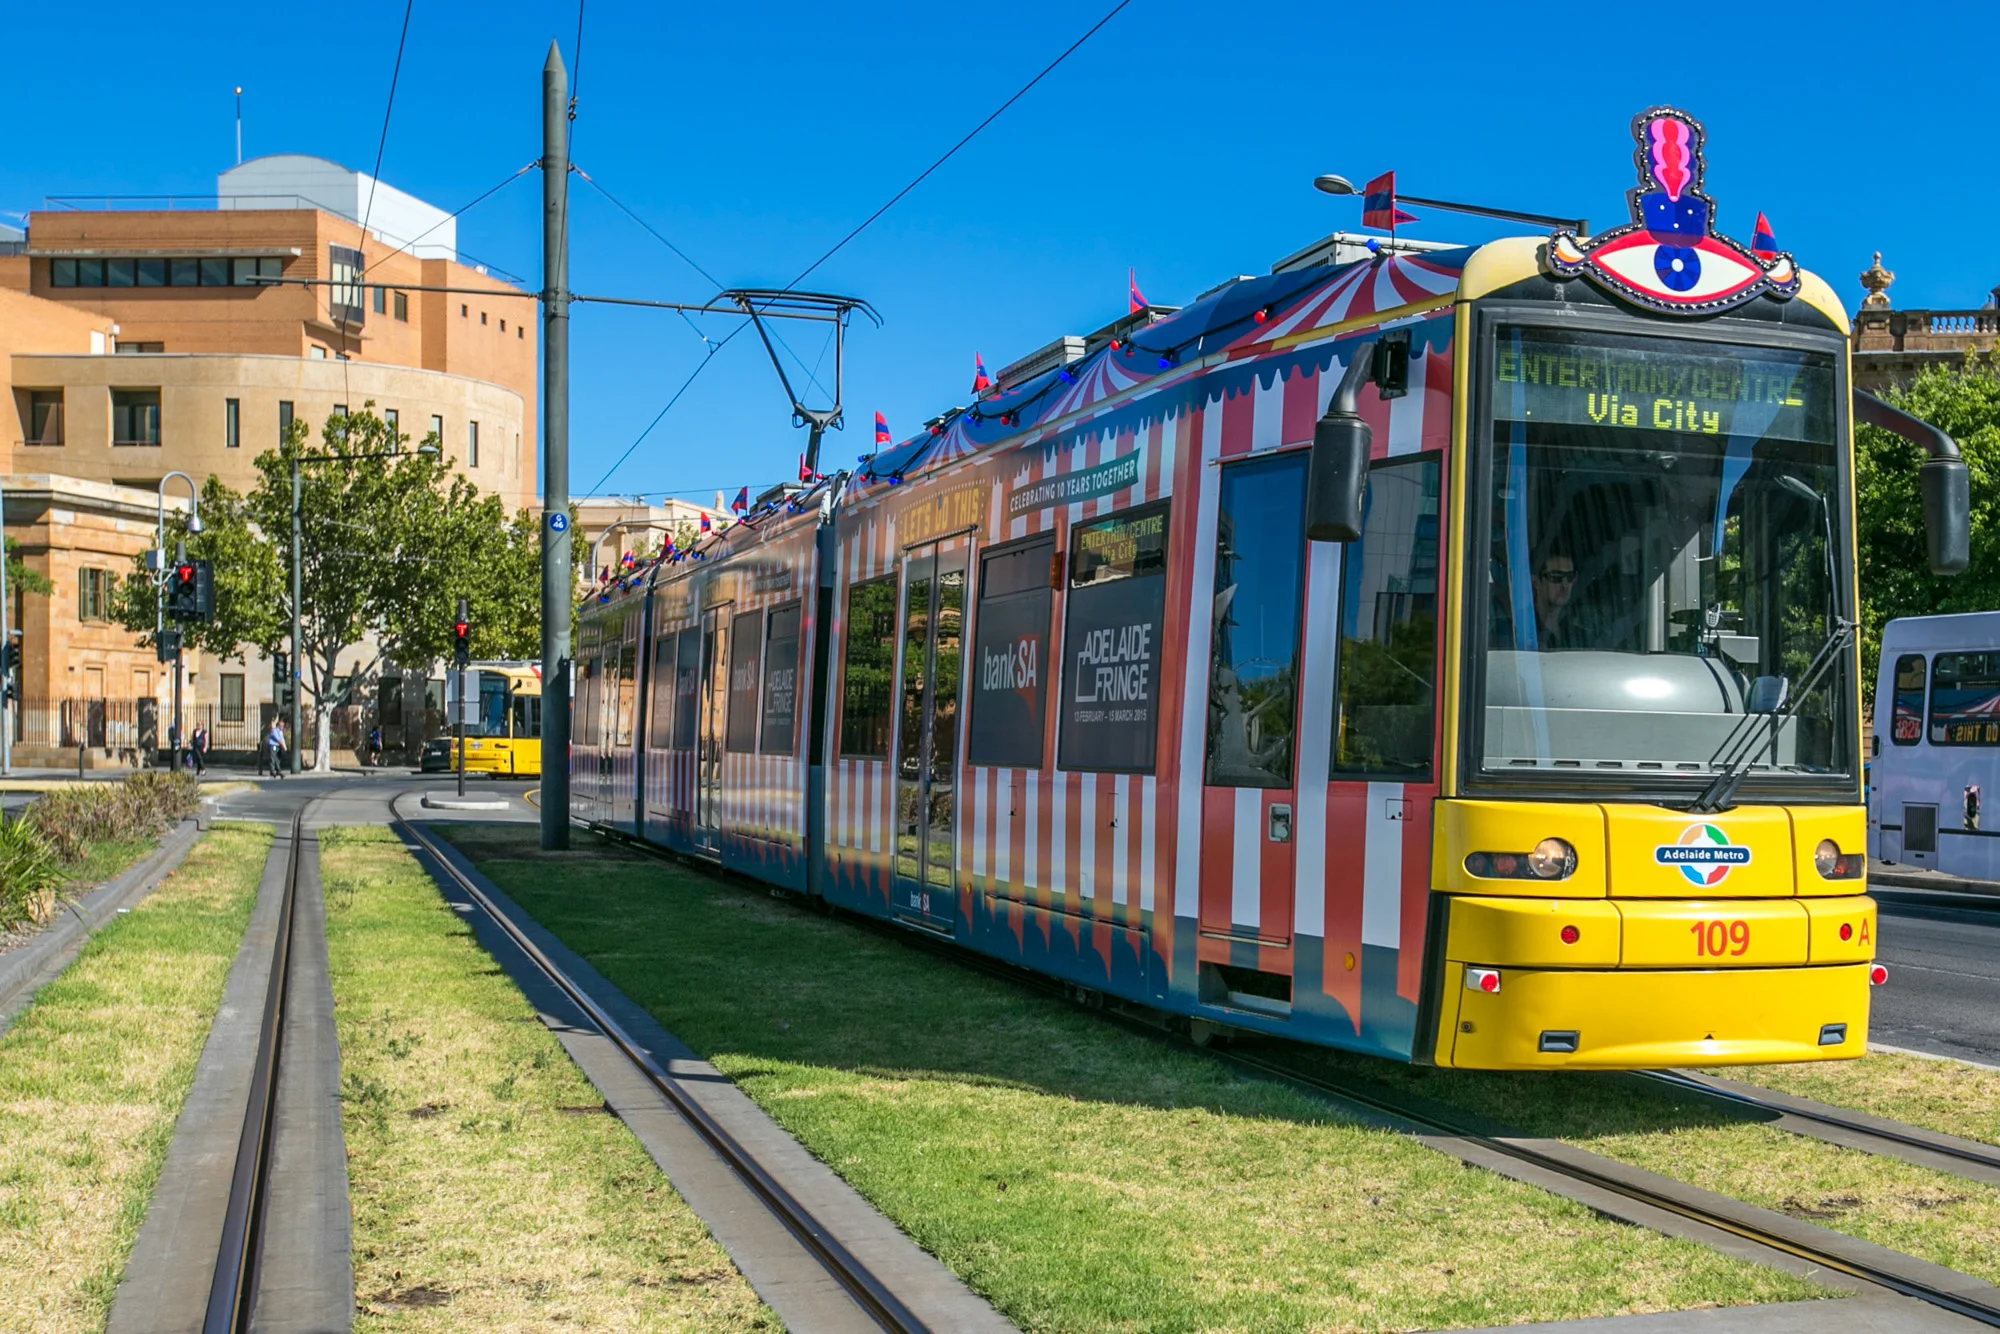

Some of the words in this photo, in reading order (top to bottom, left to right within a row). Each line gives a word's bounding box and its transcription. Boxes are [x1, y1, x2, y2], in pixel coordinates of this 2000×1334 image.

[1499, 352, 1804, 406] ENTERTAIN/CENTRE
[1588, 393, 1638, 427] Via
[1653, 399, 1719, 434] City
[1010, 482, 1056, 513] CELEBRATING
[1057, 481, 1065, 498] 10
[1067, 472, 1090, 497] YEARS
[1092, 458, 1135, 491] TOGETHER
[904, 502, 931, 545] LET'S
[935, 495, 949, 534] DO
[954, 487, 979, 529] THIS
[1101, 545, 1116, 562] Via
[1119, 540, 1138, 560] City
[1082, 623, 1152, 665] ADELAIDE
[1095, 663, 1149, 702] FRINGE
[1080, 710, 1104, 722] FEBRUARY
[1115, 708, 1134, 722] MARCH
[1134, 708, 1147, 721] 2015
[1664, 849, 1711, 860] Adelaide
[1714, 849, 1744, 860] Metro
[1690, 920, 1749, 957] 109
[1858, 917, 1870, 947] A
